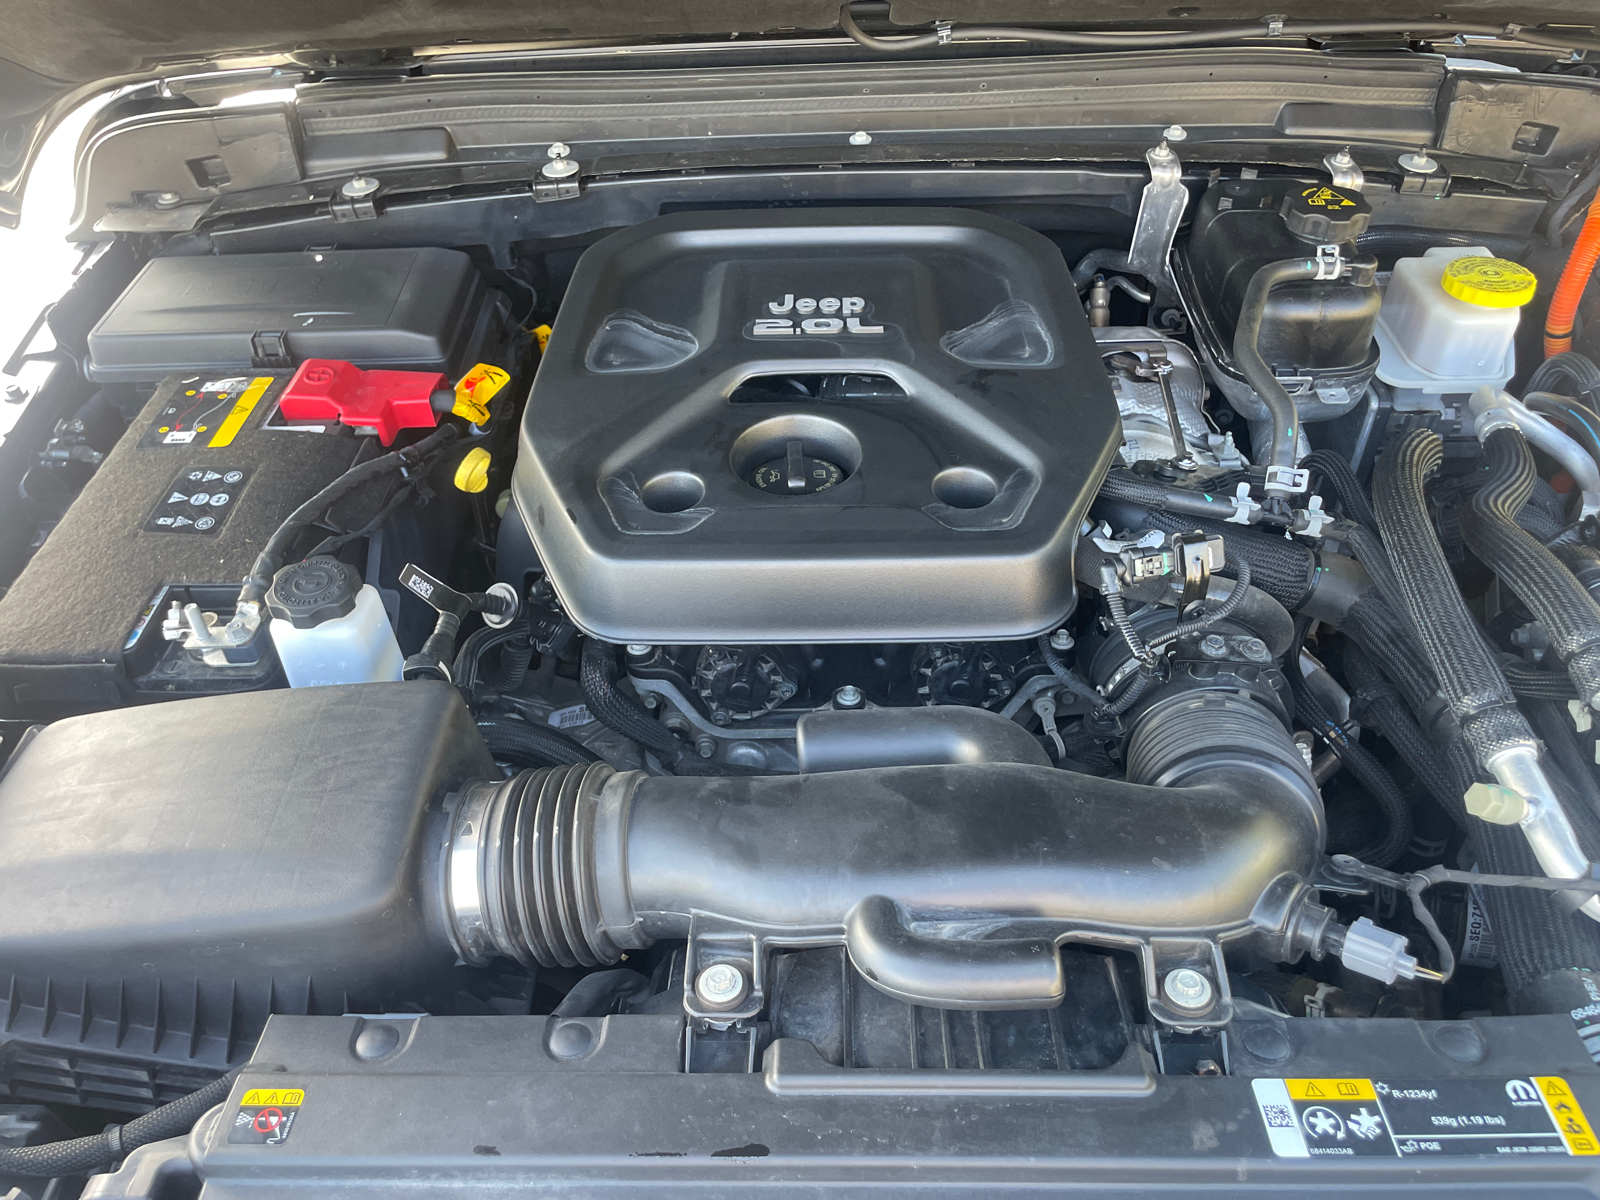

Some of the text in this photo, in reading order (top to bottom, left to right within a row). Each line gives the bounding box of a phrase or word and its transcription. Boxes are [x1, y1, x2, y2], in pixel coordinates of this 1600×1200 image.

[768, 293, 866, 317] Jeep
[752, 317, 885, 335] 2.0L
[1581, 977, 1600, 1001] PHEV
[1392, 1089, 1438, 1100] R-1234yf
[1430, 1115, 1506, 1128] 539g (1.19 lbs)
[1420, 1141, 1442, 1151] POE
